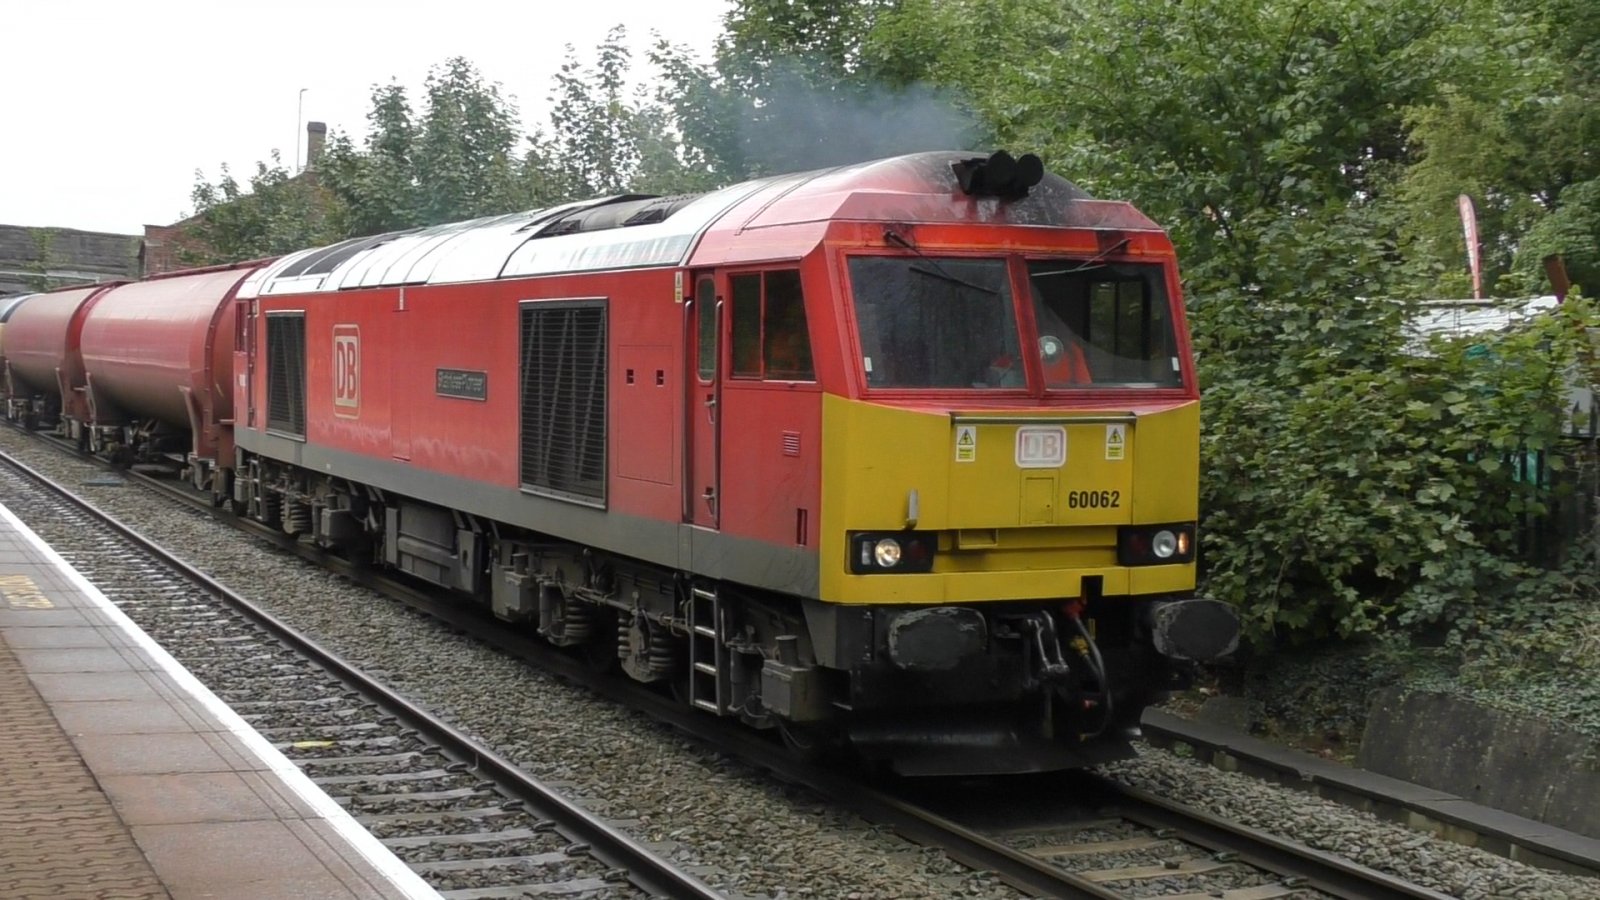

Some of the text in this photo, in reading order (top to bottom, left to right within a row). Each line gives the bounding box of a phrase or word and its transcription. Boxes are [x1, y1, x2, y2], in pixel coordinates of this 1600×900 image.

[337, 342, 356, 399] DB
[1023, 434, 1058, 458] DB
[1069, 490, 1120, 509] 60062
